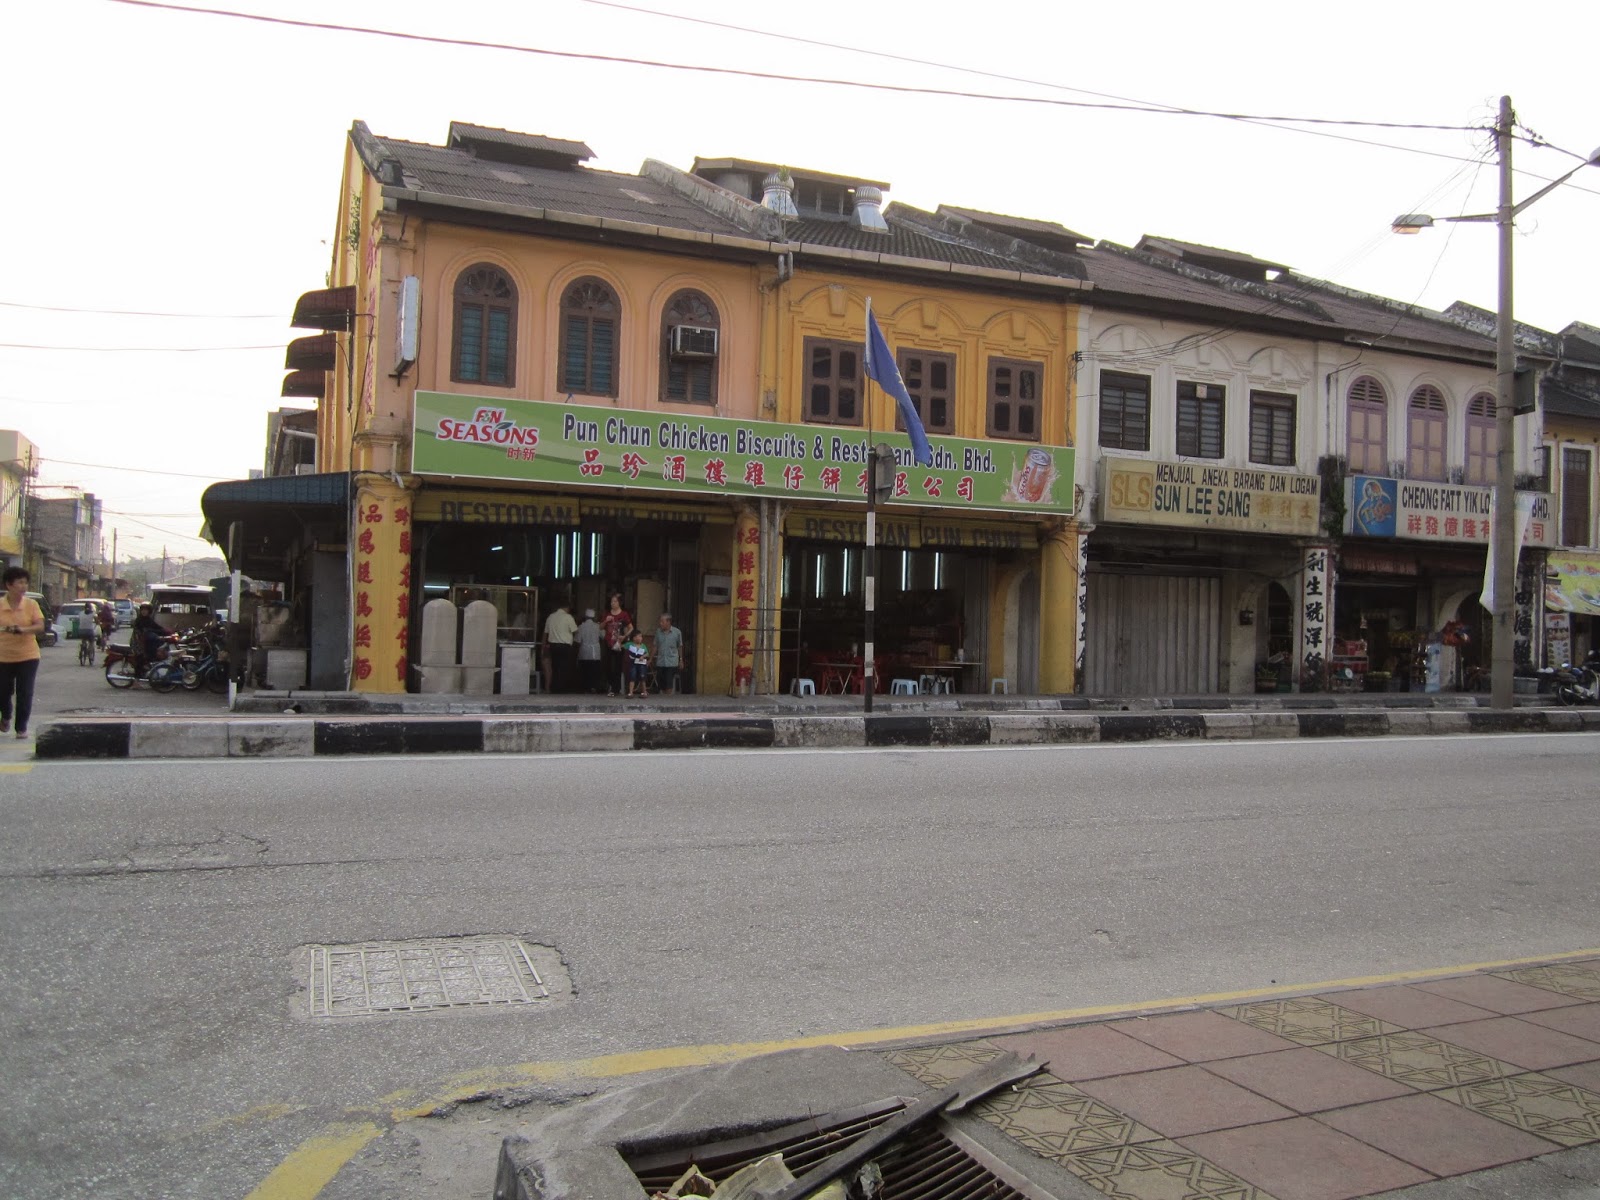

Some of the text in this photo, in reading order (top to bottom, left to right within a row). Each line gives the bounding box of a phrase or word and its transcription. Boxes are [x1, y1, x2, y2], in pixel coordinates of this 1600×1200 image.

[437, 418, 538, 445] SEASONS
[564, 413, 598, 443] Pun
[606, 417, 651, 447] Chun
[658, 422, 729, 454] Chicken
[736, 428, 805, 460] Biscuits
[813, 435, 825, 460] &
[964, 447, 996, 473] Bhd.
[507, 447, 536, 463] 时新
[1111, 473, 1150, 508] SLS
[1156, 464, 1318, 496] MENJUAL ANEKA BARANG DAN LOGAM
[1154, 485, 1250, 518] SUN LEE SANG
[1402, 486, 1438, 511] CHEONG
[1440, 489, 1462, 513] FATT
[1464, 491, 1478, 514] YIK
